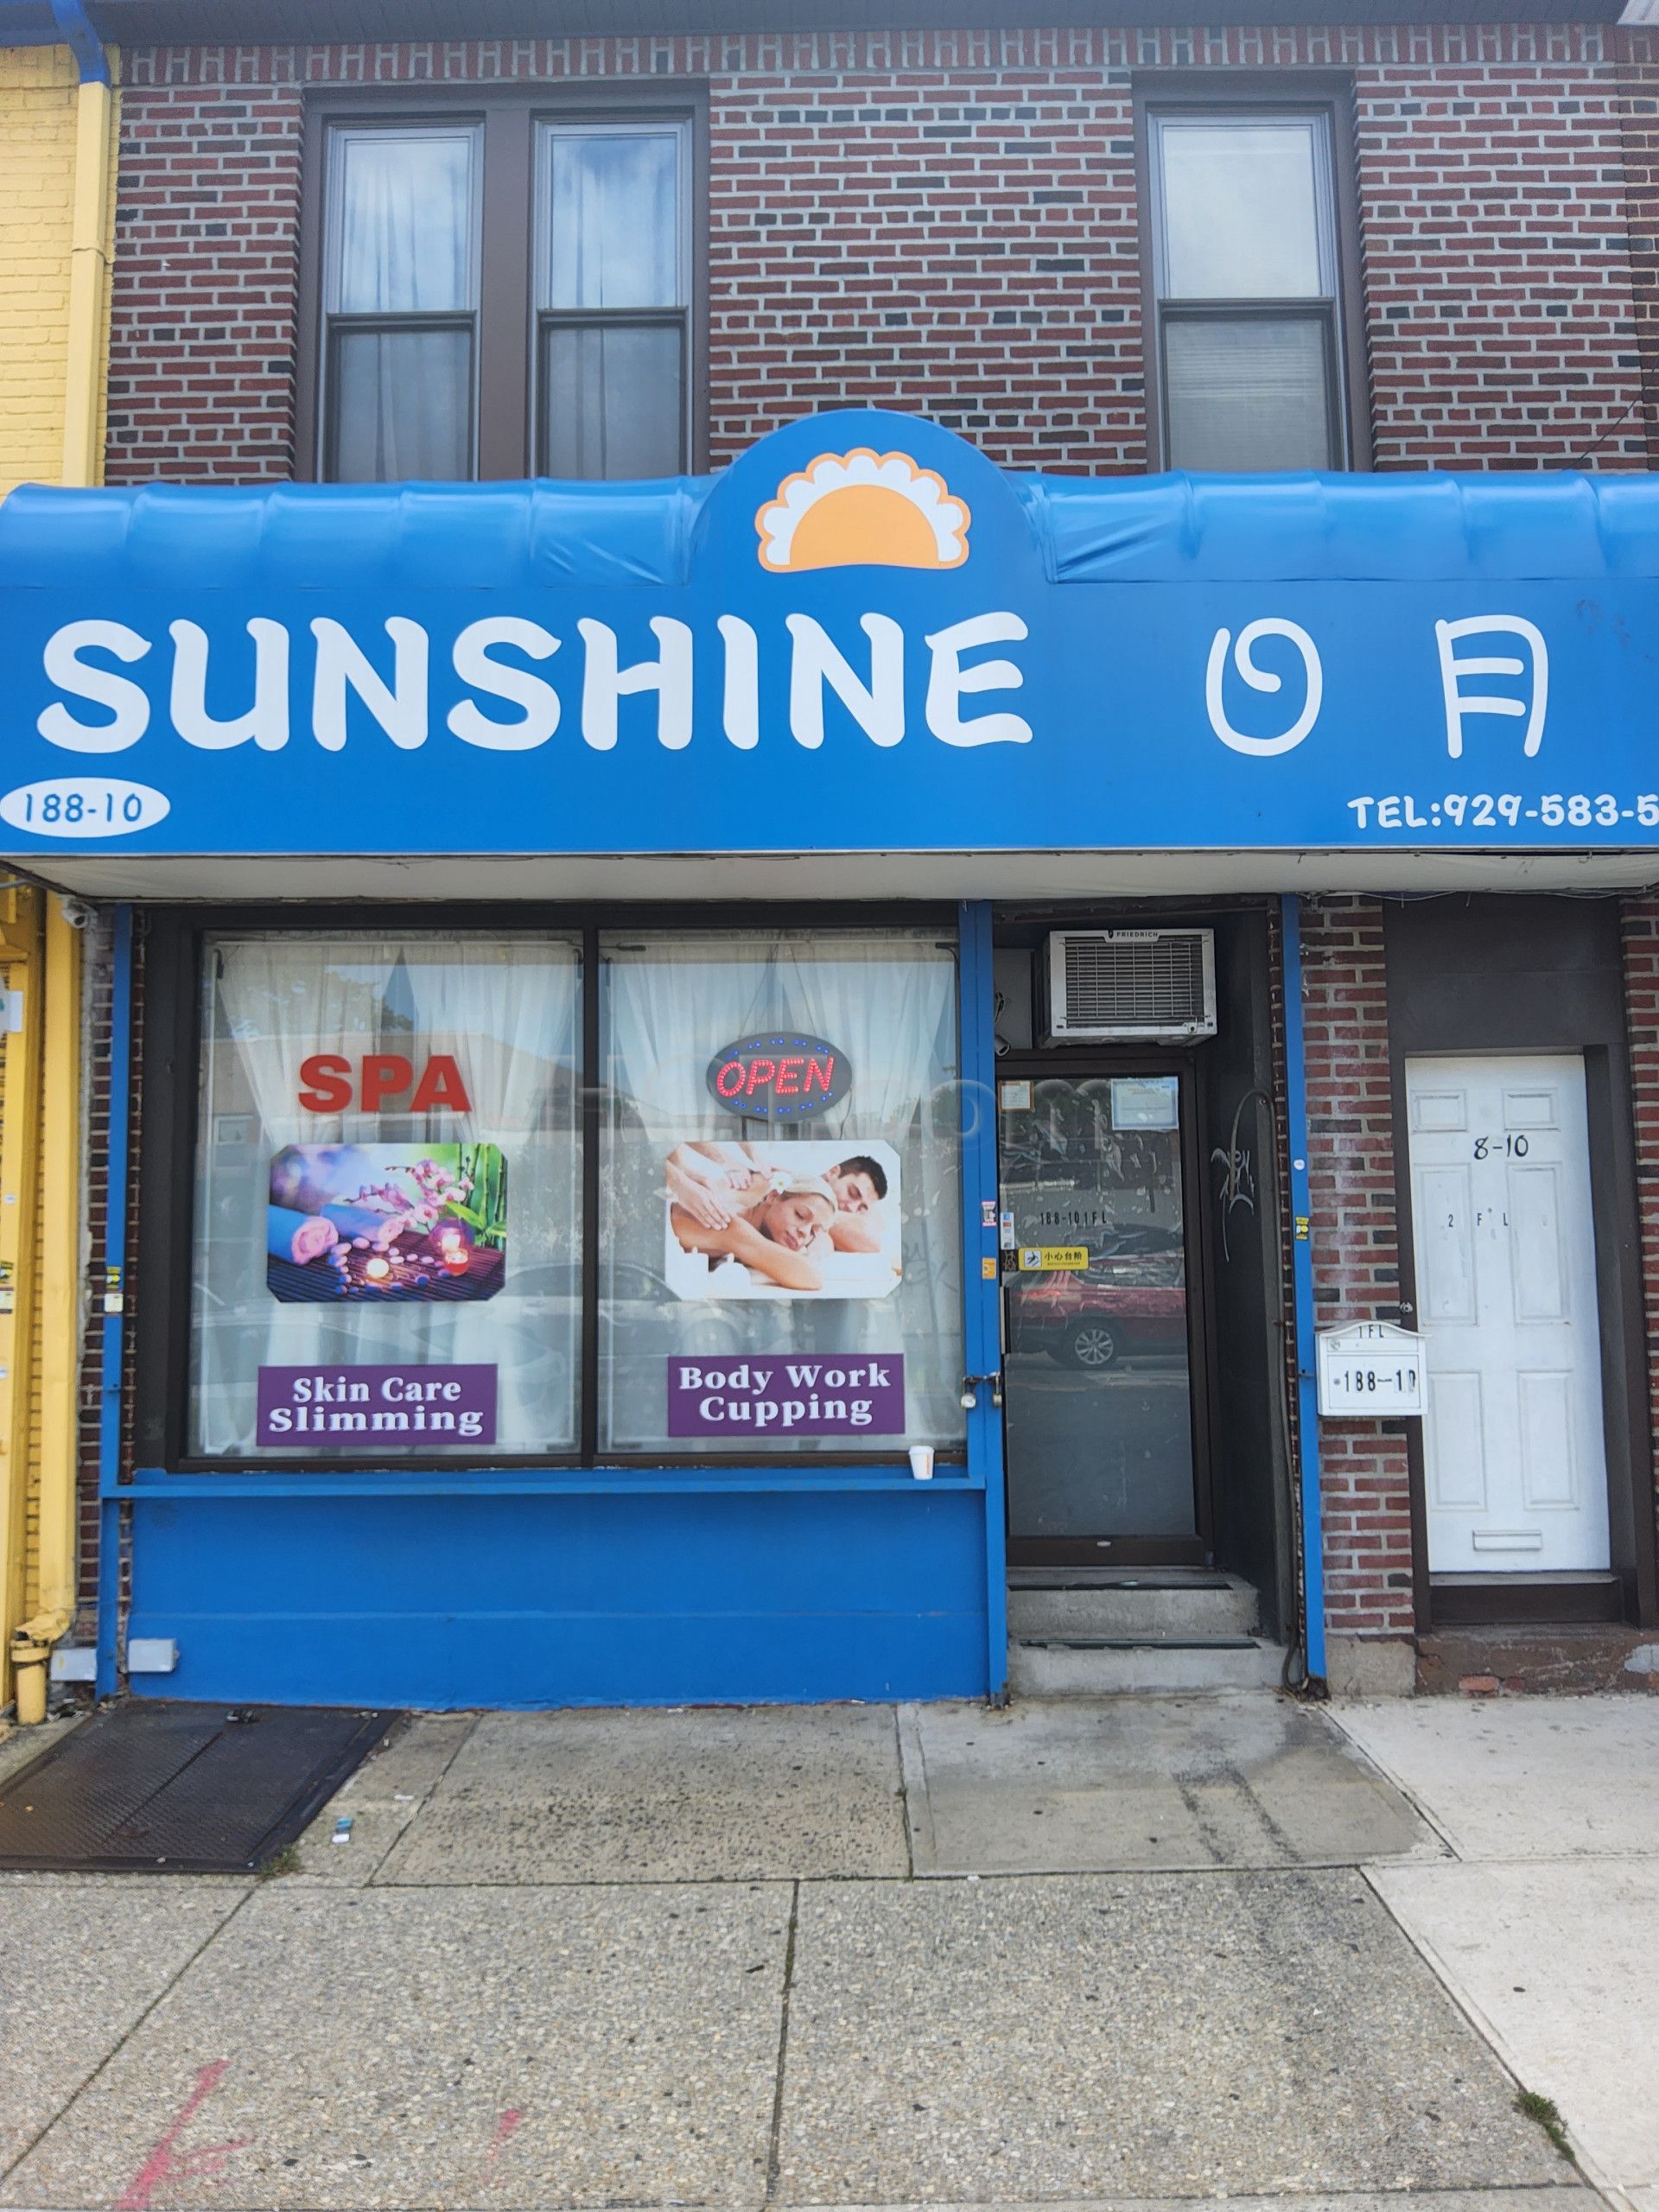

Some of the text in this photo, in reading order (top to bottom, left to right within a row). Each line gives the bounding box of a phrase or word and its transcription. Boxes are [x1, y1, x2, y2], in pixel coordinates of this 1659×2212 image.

[36, 611, 1033, 754] SUNSHINE
[23, 792, 143, 824] 188-10
[298, 1054, 473, 1113] SPA
[716, 1056, 836, 1097] OPEN
[292, 1376, 461, 1403] Skin Care
[678, 1363, 891, 1395] Body Work
[269, 1405, 484, 1437] Slimming
[699, 1393, 873, 1427] Cupping
